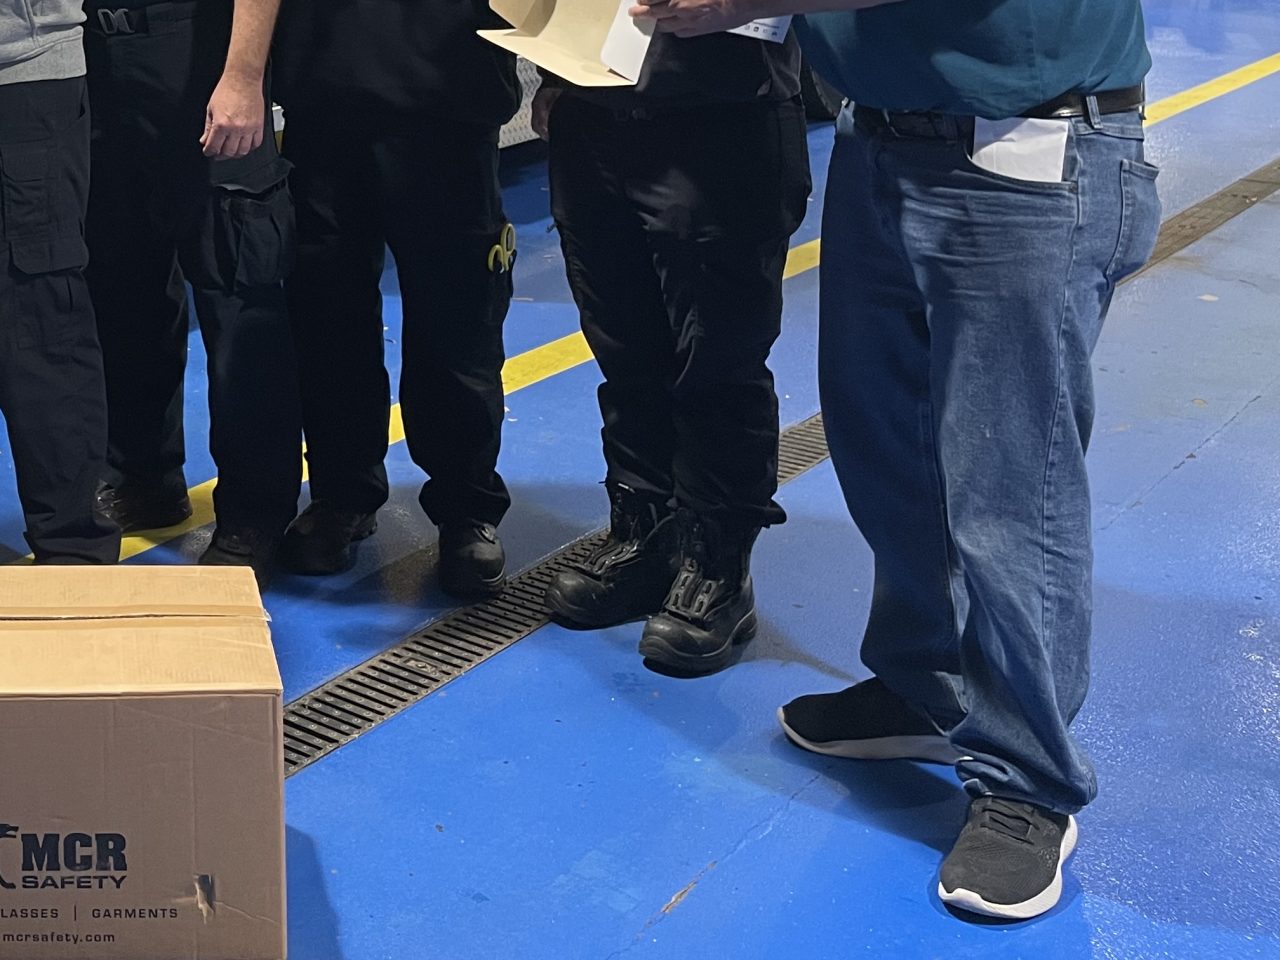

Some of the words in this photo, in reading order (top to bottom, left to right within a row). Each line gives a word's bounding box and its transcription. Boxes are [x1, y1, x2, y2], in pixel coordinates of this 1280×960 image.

[21, 832, 127, 871] MCR
[22, 875, 127, 889] SAFETY
[92, 908, 178, 919] GARMENTS
